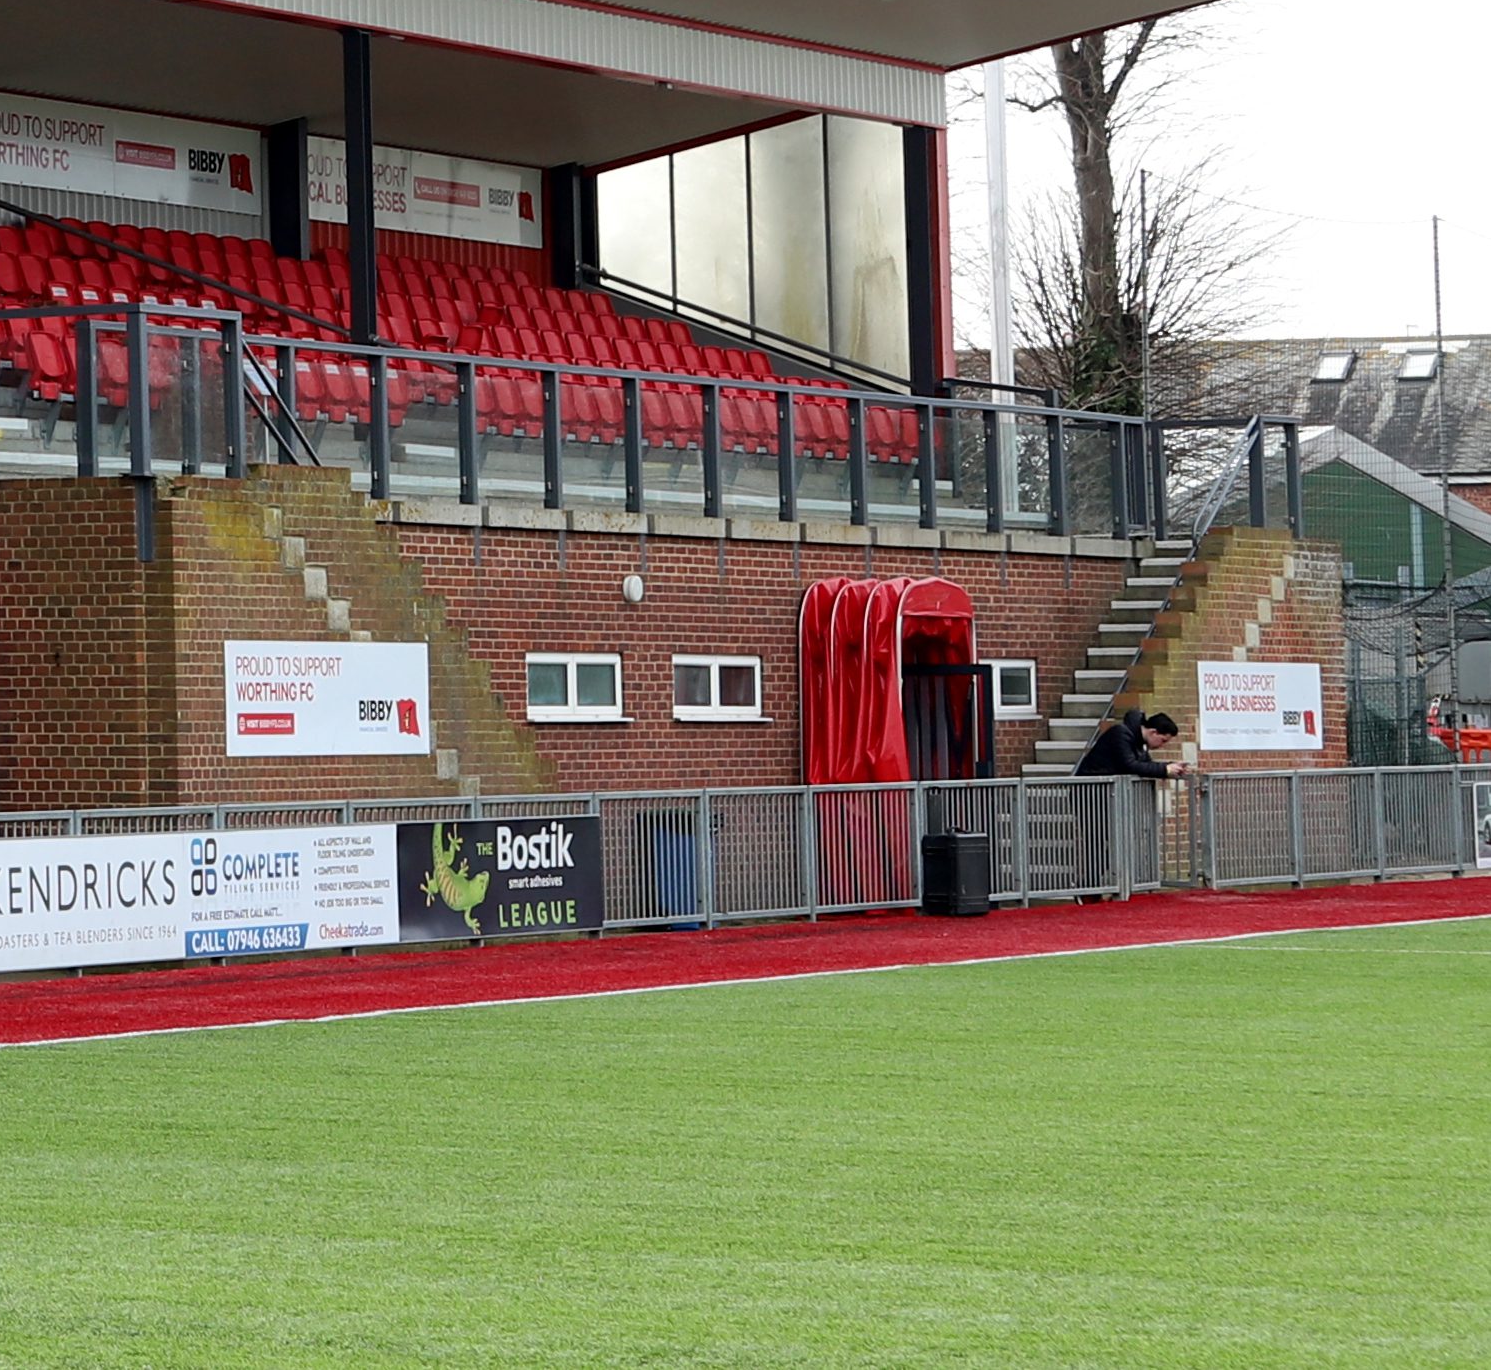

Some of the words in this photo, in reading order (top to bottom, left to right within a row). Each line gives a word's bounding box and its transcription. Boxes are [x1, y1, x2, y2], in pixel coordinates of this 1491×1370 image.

[188, 149, 225, 174] BIBBY
[488, 188, 515, 206] BIBBY
[1204, 674, 1229, 690] PROUD
[1231, 674, 1241, 690] TO
[1243, 675, 1275, 691] SUPPORT
[359, 700, 393, 721] BIBBY
[1205, 695, 1229, 711] LOCAL
[1232, 695, 1276, 711] BUSINESSES
[476, 842, 493, 855] THE
[497, 821, 574, 870] Bostik
[223, 852, 299, 881] COMPLETE
[223, 884, 254, 894] TILING
[259, 881, 300, 892] SERVICES
[509, 877, 529, 889] smart
[530, 874, 563, 887] adhesives
[499, 900, 576, 928] LEAGUE
[54, 931, 71, 945] TEA
[76, 928, 123, 943] BLENDERS
[127, 926, 153, 940] SINCE
[158, 925, 177, 938] 1964
[192, 932, 224, 953] CALL:
[227, 929, 261, 951] 07946
[263, 926, 300, 948] 636433
[319, 921, 383, 939] Checkatrade.com
